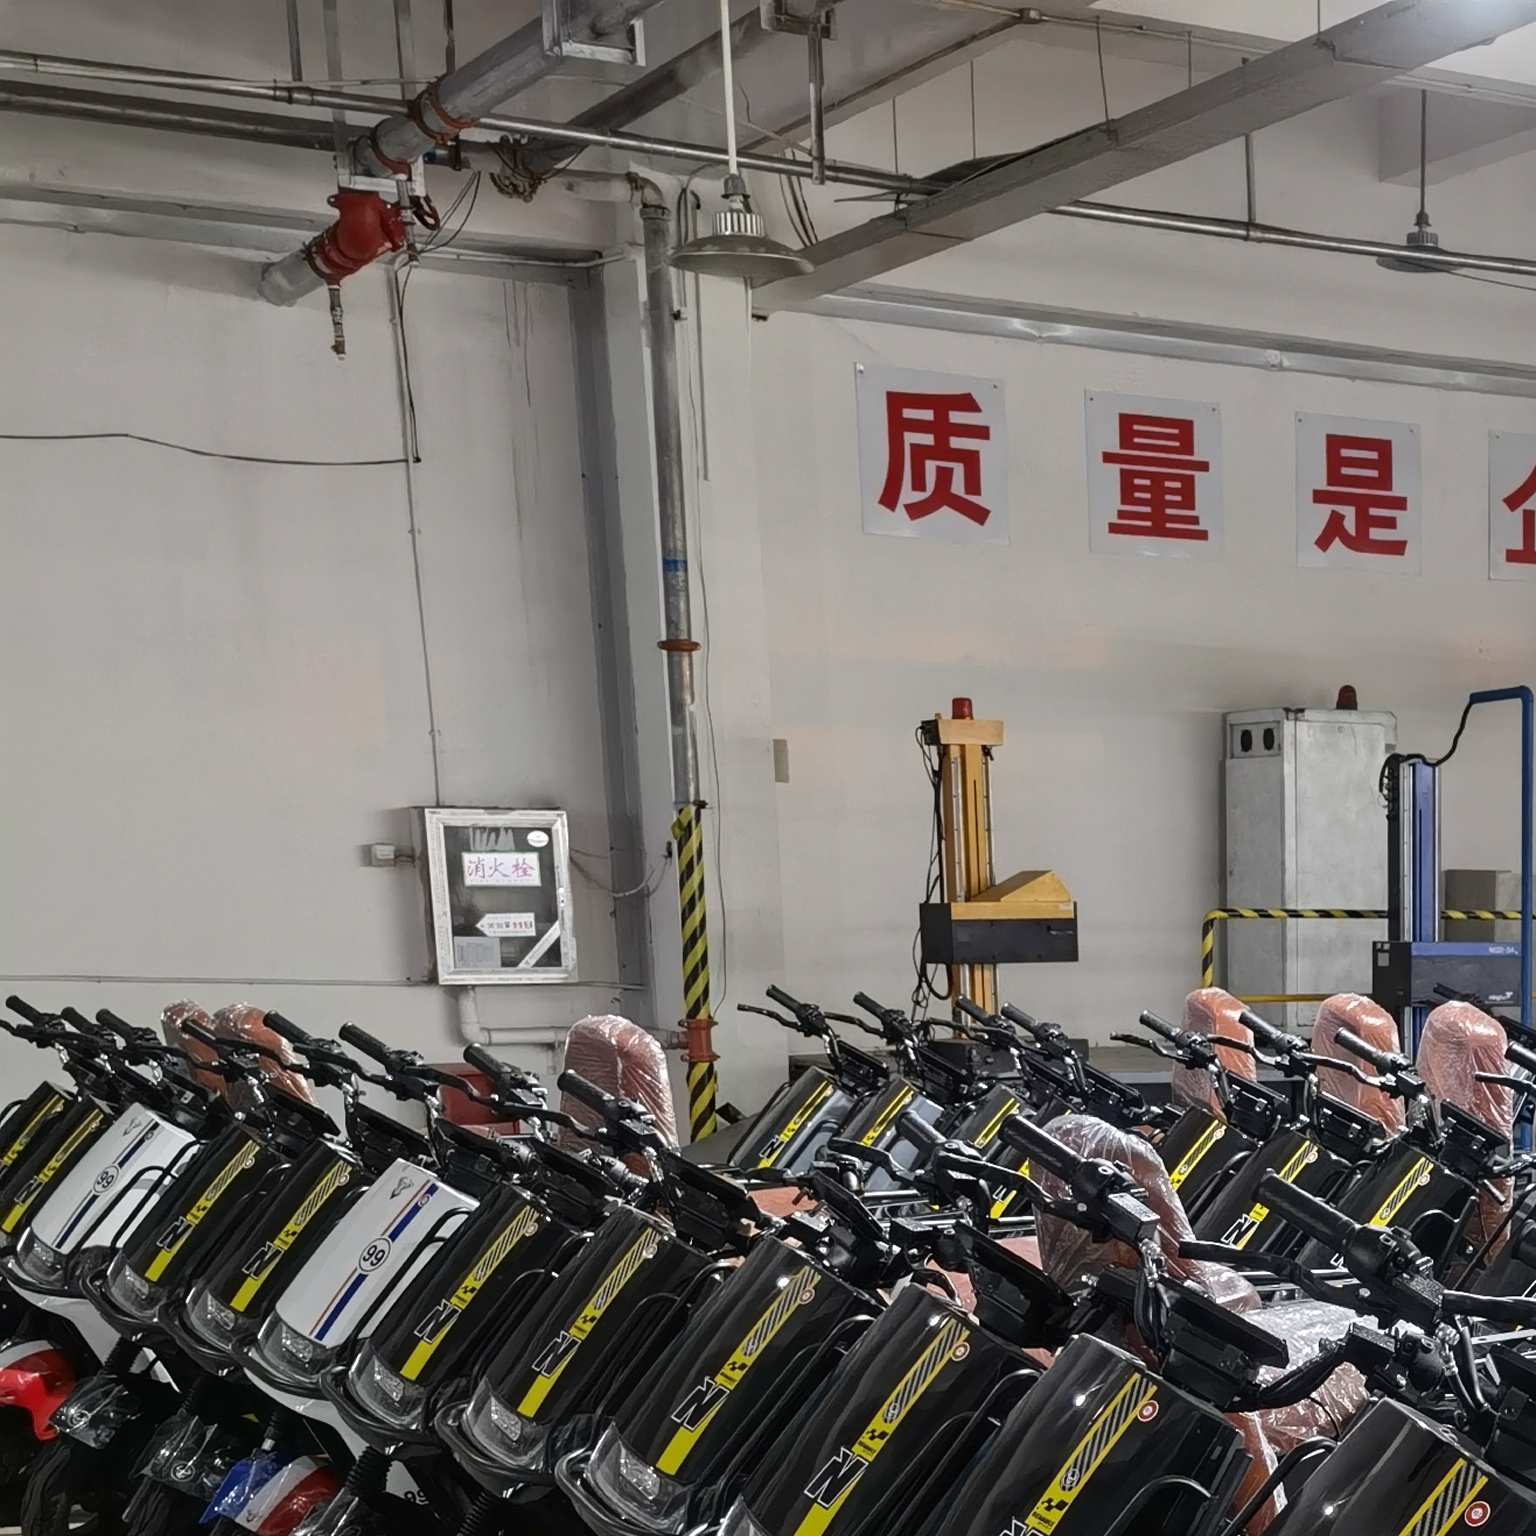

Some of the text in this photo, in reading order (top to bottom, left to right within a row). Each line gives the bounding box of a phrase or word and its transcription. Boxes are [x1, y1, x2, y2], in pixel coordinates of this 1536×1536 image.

[467, 856, 536, 880] 消火栓
[96, 1170, 115, 1189] 99
[362, 1244, 386, 1267] 99
[414, 1299, 462, 1344] N
[532, 1330, 582, 1378] N
[672, 1376, 730, 1432] N
[804, 1446, 869, 1508] N
